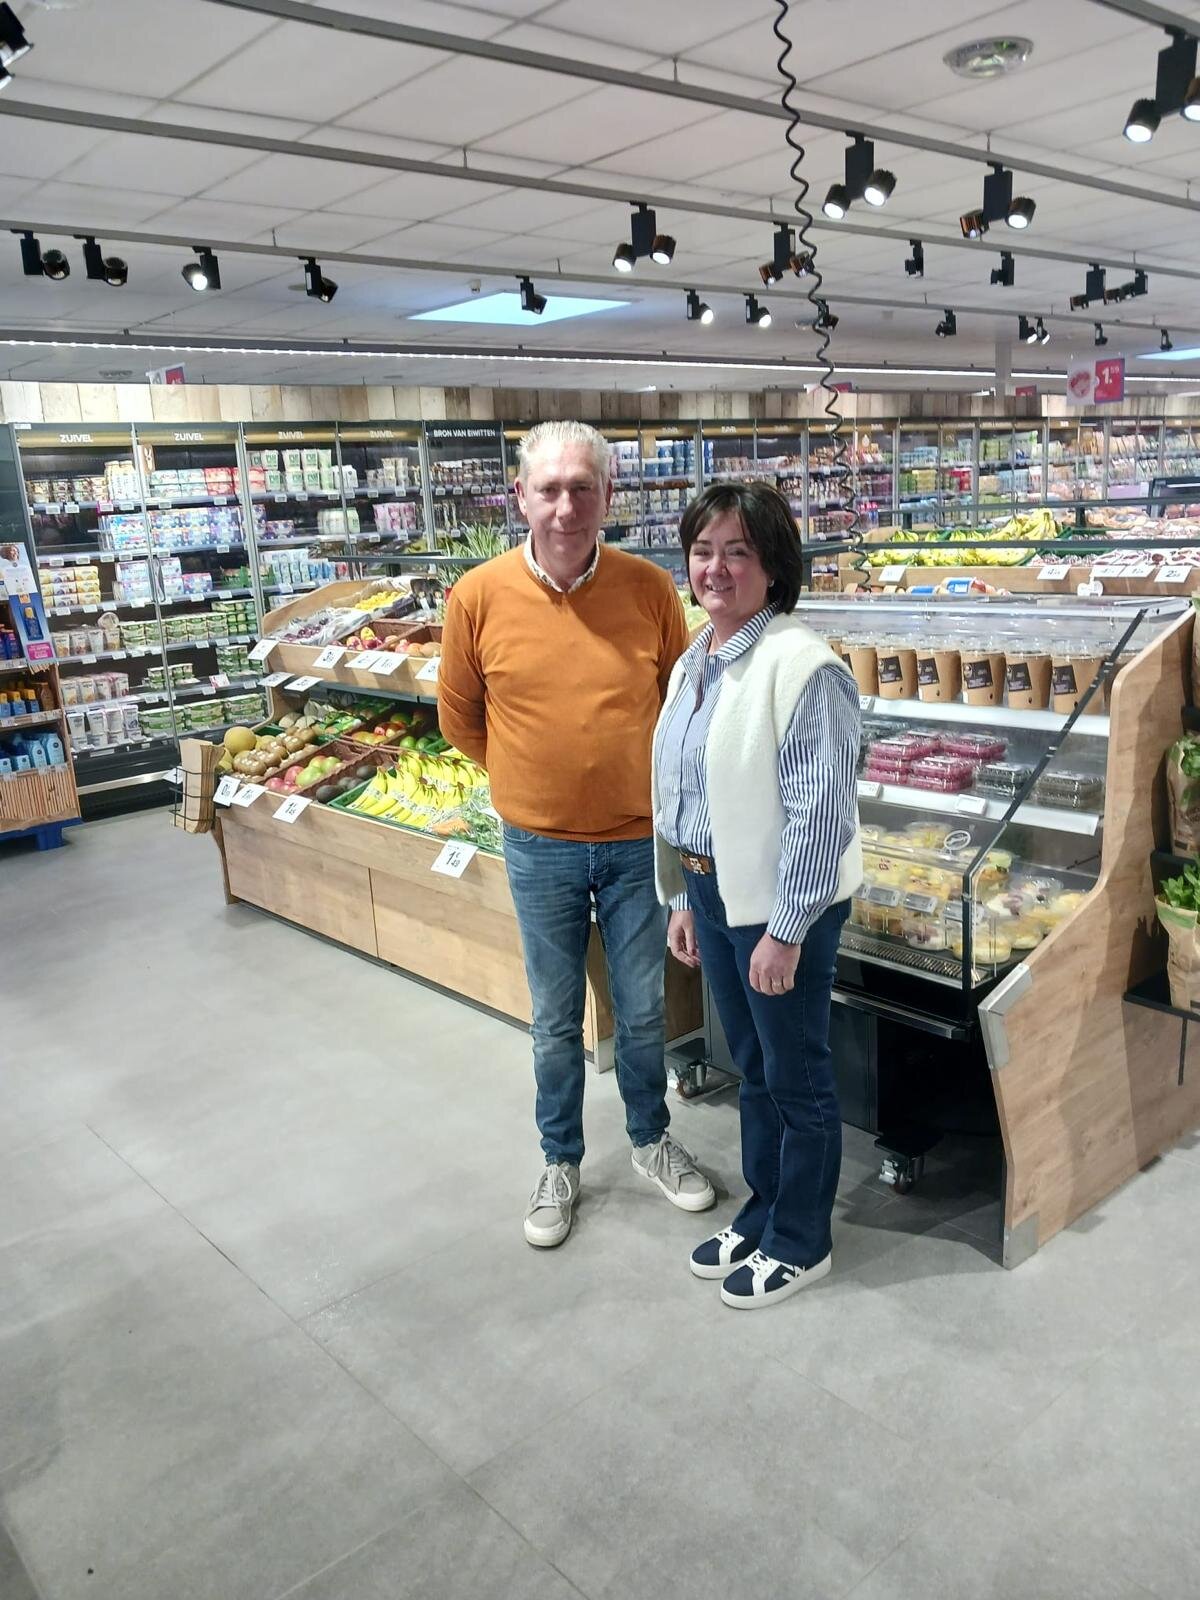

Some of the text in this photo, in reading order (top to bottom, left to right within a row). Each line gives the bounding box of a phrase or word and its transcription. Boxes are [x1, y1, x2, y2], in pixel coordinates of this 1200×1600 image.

[174, 432, 204, 441] ZUIVEL
[433, 429, 453, 437] BRON
[453, 429, 467, 437] VAN
[59, 434, 93, 443] ZUIVEL
